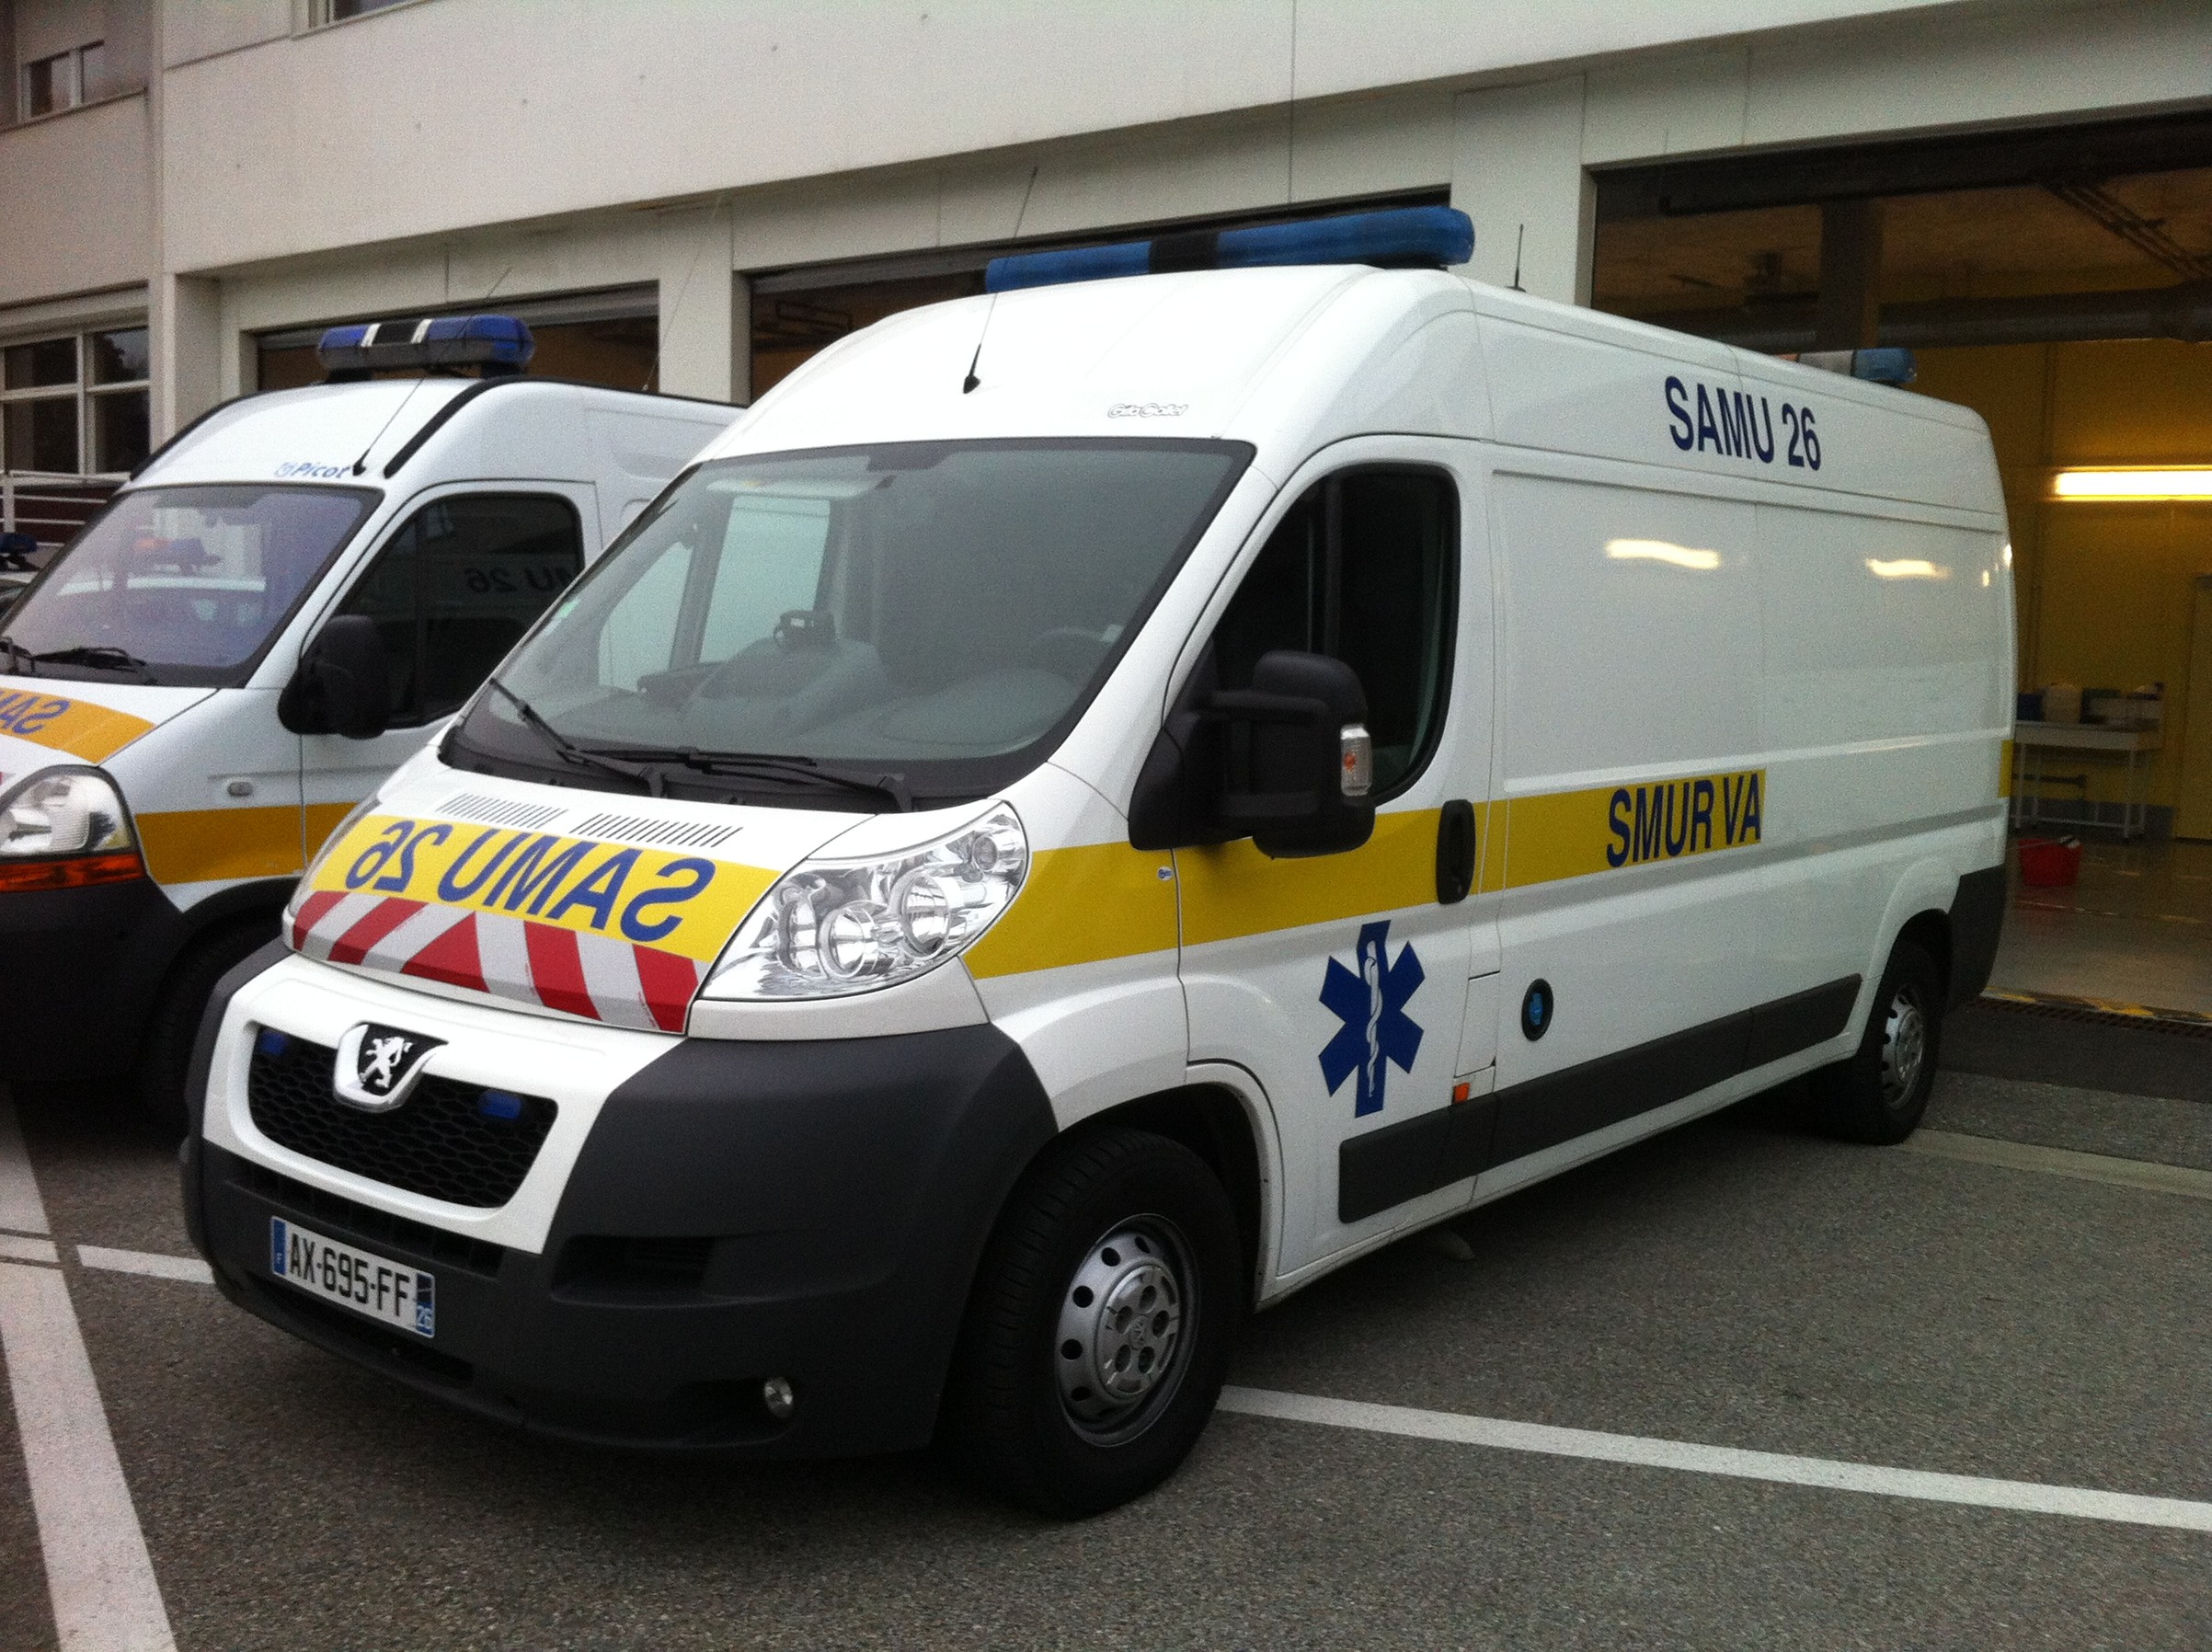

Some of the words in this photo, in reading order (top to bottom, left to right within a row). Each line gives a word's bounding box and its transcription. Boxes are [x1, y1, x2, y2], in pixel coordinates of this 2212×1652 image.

[1665, 376, 1774, 464] SAMU
[1782, 403, 1821, 471] 26
[1607, 779, 1715, 867] SMUR
[1724, 774, 1762, 844] VA
[290, 1233, 410, 1316] AX-695-FF
